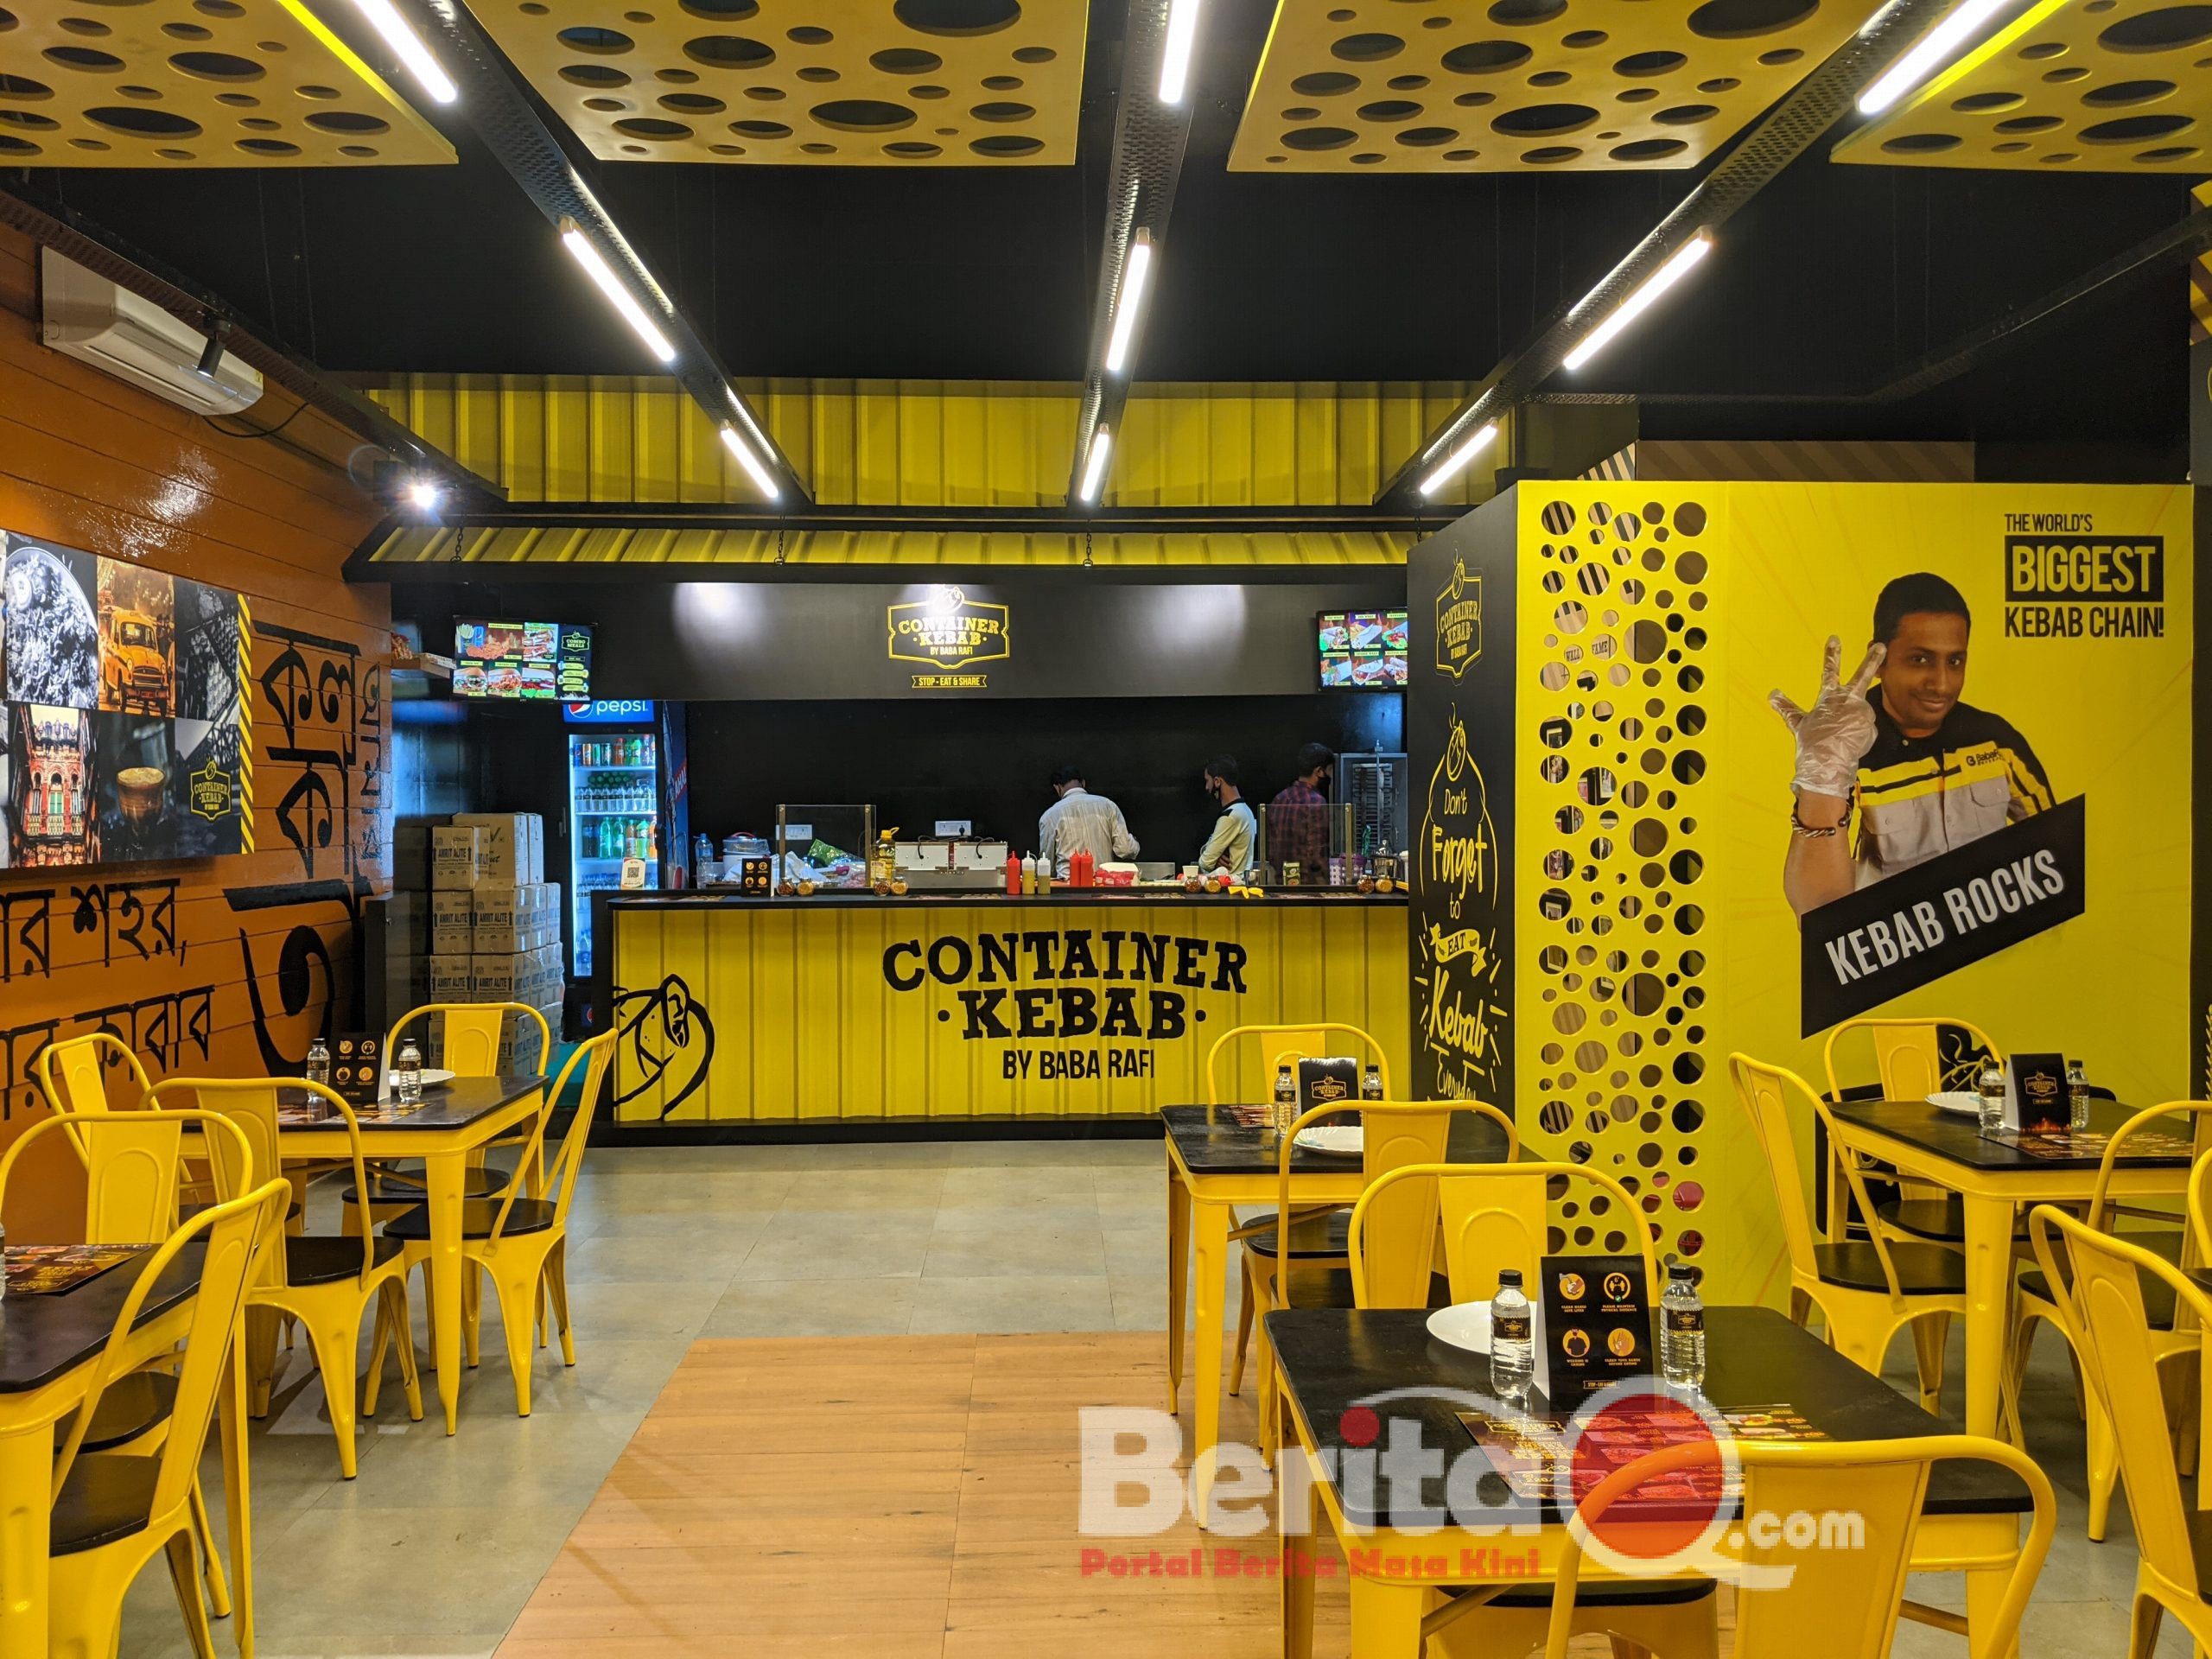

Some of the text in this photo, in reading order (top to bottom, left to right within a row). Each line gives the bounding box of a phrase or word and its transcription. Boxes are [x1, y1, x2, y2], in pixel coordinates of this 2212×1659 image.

[2004, 513, 2093, 532] THE WORLD'S
[2012, 544, 2156, 593] BIGGEST
[898, 615, 1000, 635] CONTAINER
[1440, 600, 1478, 634] CONTAINER
[2005, 607, 2164, 638] KEBAB CHAIN!
[918, 630, 982, 646] KEBAB
[1446, 621, 1471, 648] KEBAB
[930, 646, 973, 656] BY BABA RAFI
[1566, 640, 1608, 662] WALL FAME
[918, 677, 936, 686] STOP
[939, 677, 952, 686] EAT
[959, 677, 981, 686] SHARE
[596, 700, 645, 716] pepsi
[194, 781, 228, 796] CONTAINER
[200, 792, 222, 804] KEBAB
[1444, 788, 1468, 816] Don't
[1432, 823, 1488, 899] Forget
[1449, 892, 1460, 920] to
[1825, 849, 2064, 985] KEBAB ROCKS
[1446, 931, 1466, 953] EAT
[882, 929, 1248, 994] CONTAINER
[957, 987, 1186, 1040] KEBAB
[1429, 965, 1488, 1058] Kebab
[1002, 1048, 1154, 1079] BY BABA RAFI
